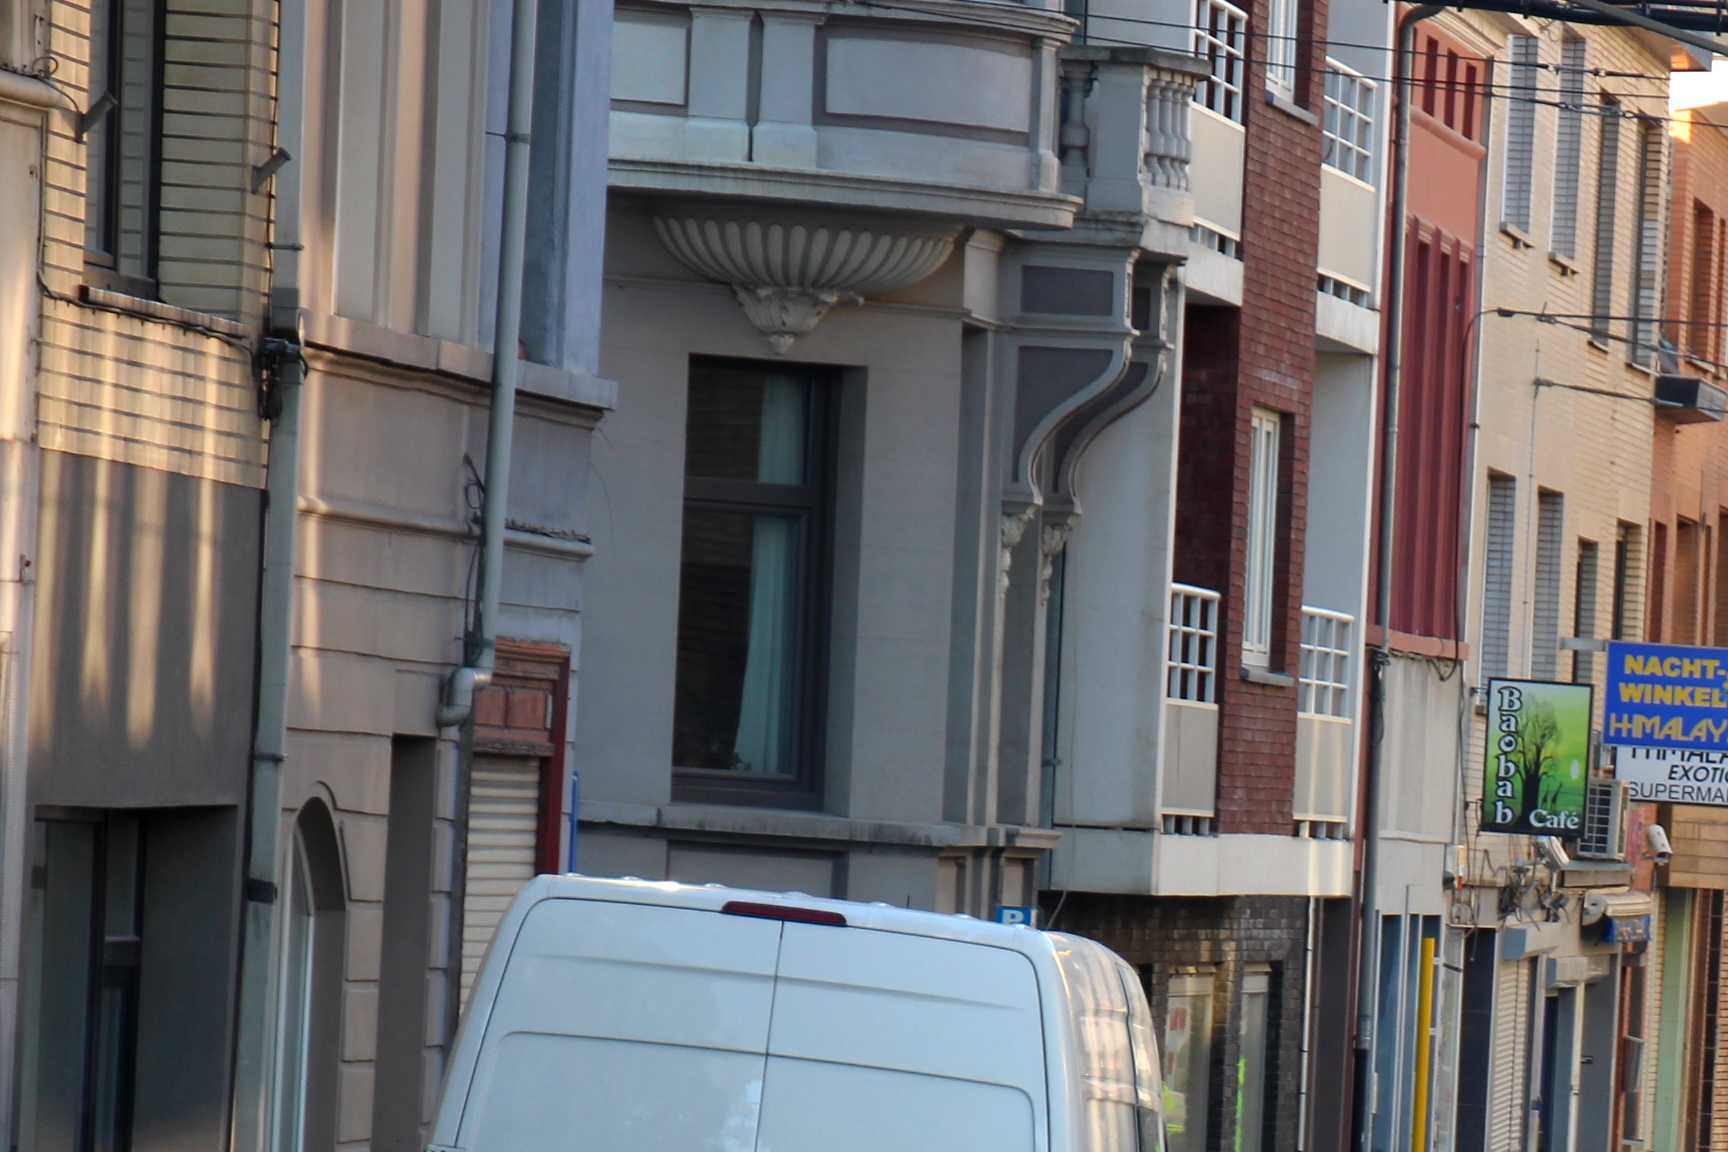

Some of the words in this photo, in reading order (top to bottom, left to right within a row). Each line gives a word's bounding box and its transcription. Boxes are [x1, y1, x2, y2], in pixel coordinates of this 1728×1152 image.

[1624, 654, 1726, 679] NACHT-
[1619, 682, 1728, 708] WINKEL
[1494, 686, 1522, 824] Baobab
[1529, 809, 1579, 830] Café
[1003, 909, 1024, 926] P
